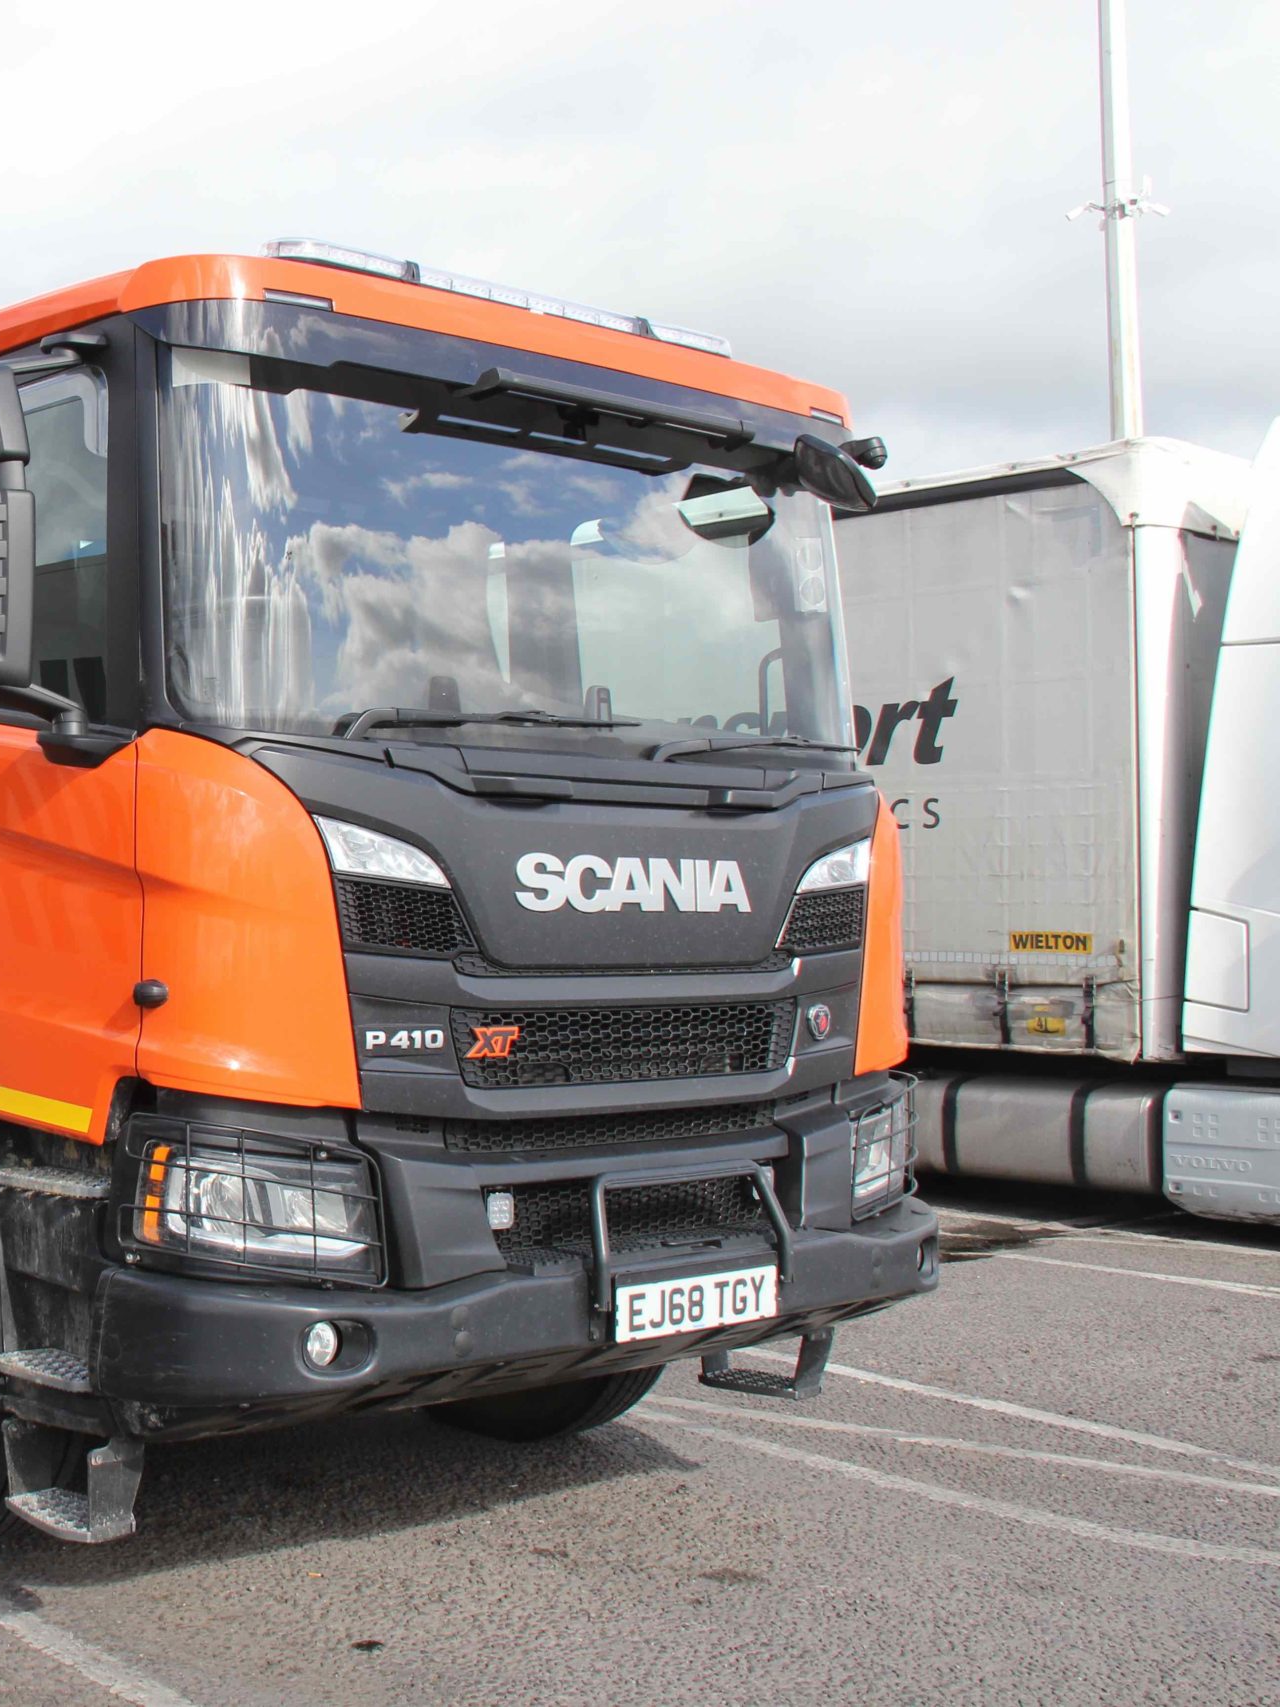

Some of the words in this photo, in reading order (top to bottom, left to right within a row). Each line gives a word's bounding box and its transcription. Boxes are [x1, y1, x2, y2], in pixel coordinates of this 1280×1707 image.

[515, 852, 752, 913] SCANIA
[1012, 934, 1087, 951] WIELTON
[365, 1031, 386, 1050] P
[390, 1029, 444, 1049] 410
[464, 1027, 520, 1058] XT
[1170, 1154, 1252, 1172] VOLVO
[629, 1284, 704, 1332] EJ68
[714, 1275, 765, 1318] TGY
